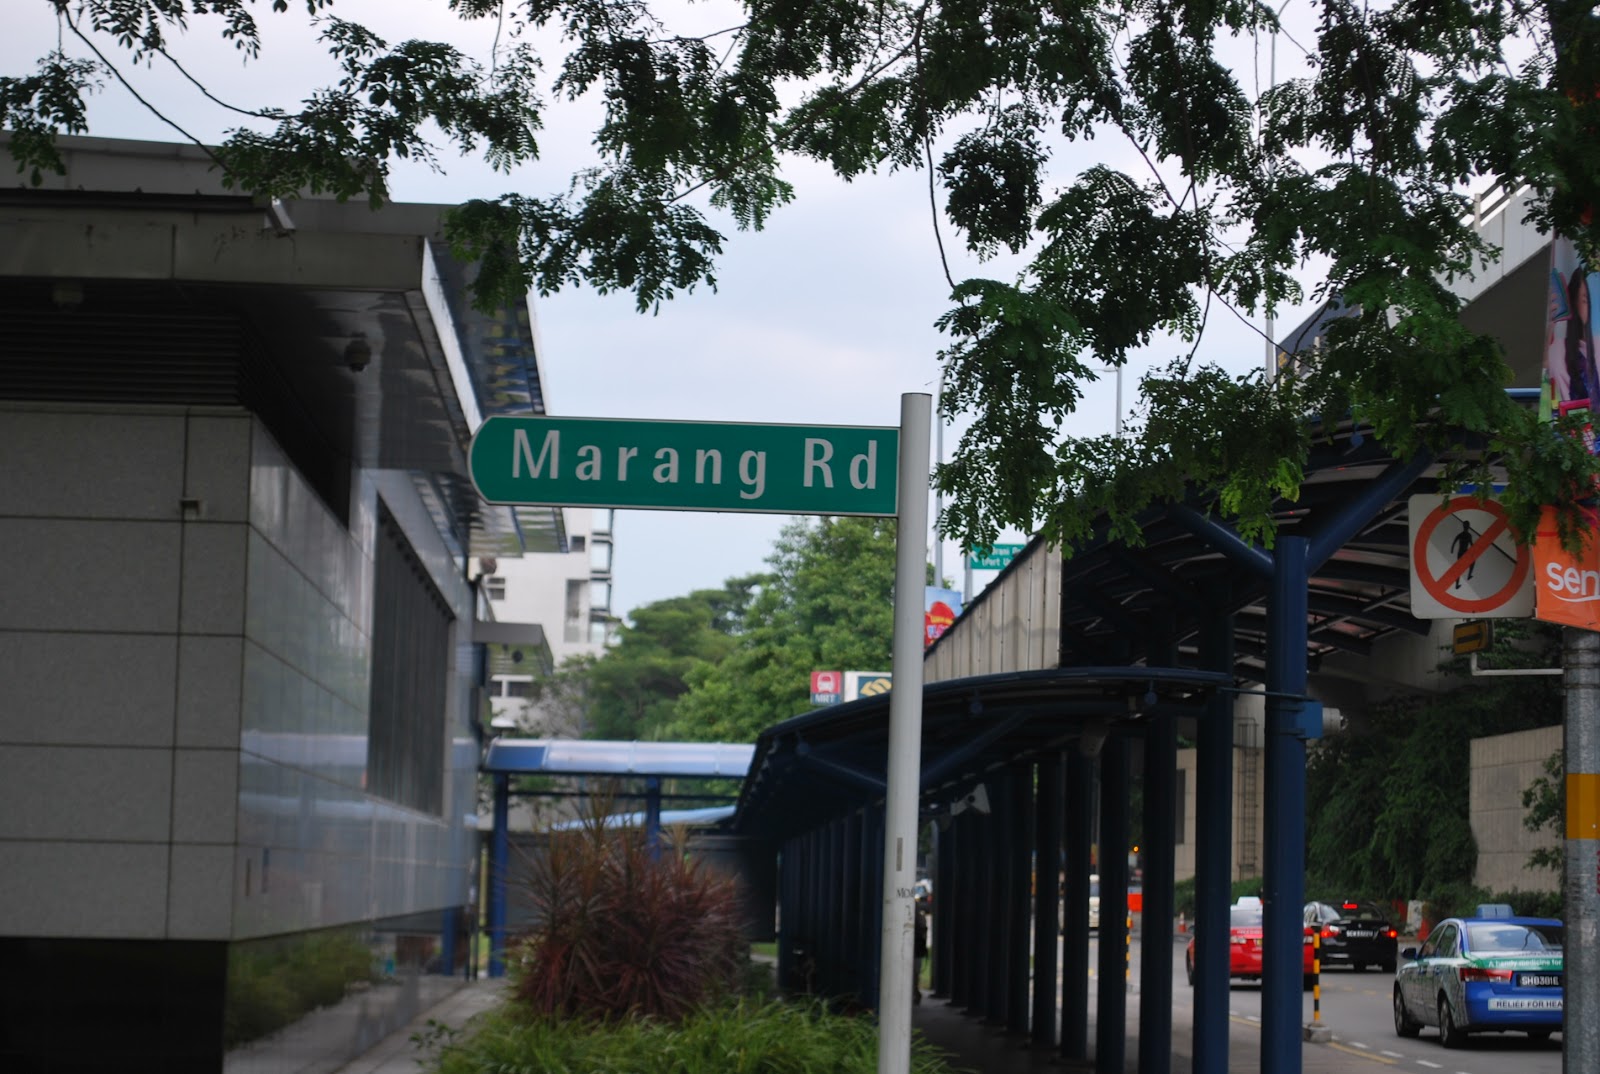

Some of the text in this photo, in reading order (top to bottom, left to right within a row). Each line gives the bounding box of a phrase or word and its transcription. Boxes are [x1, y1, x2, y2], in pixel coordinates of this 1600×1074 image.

[512, 428, 877, 500] Marang Rd
[815, 693, 835, 703] MRT
[1496, 959, 1518, 968] handy
[1519, 958, 1551, 966] medicine
[1551, 958, 1562, 966] for
